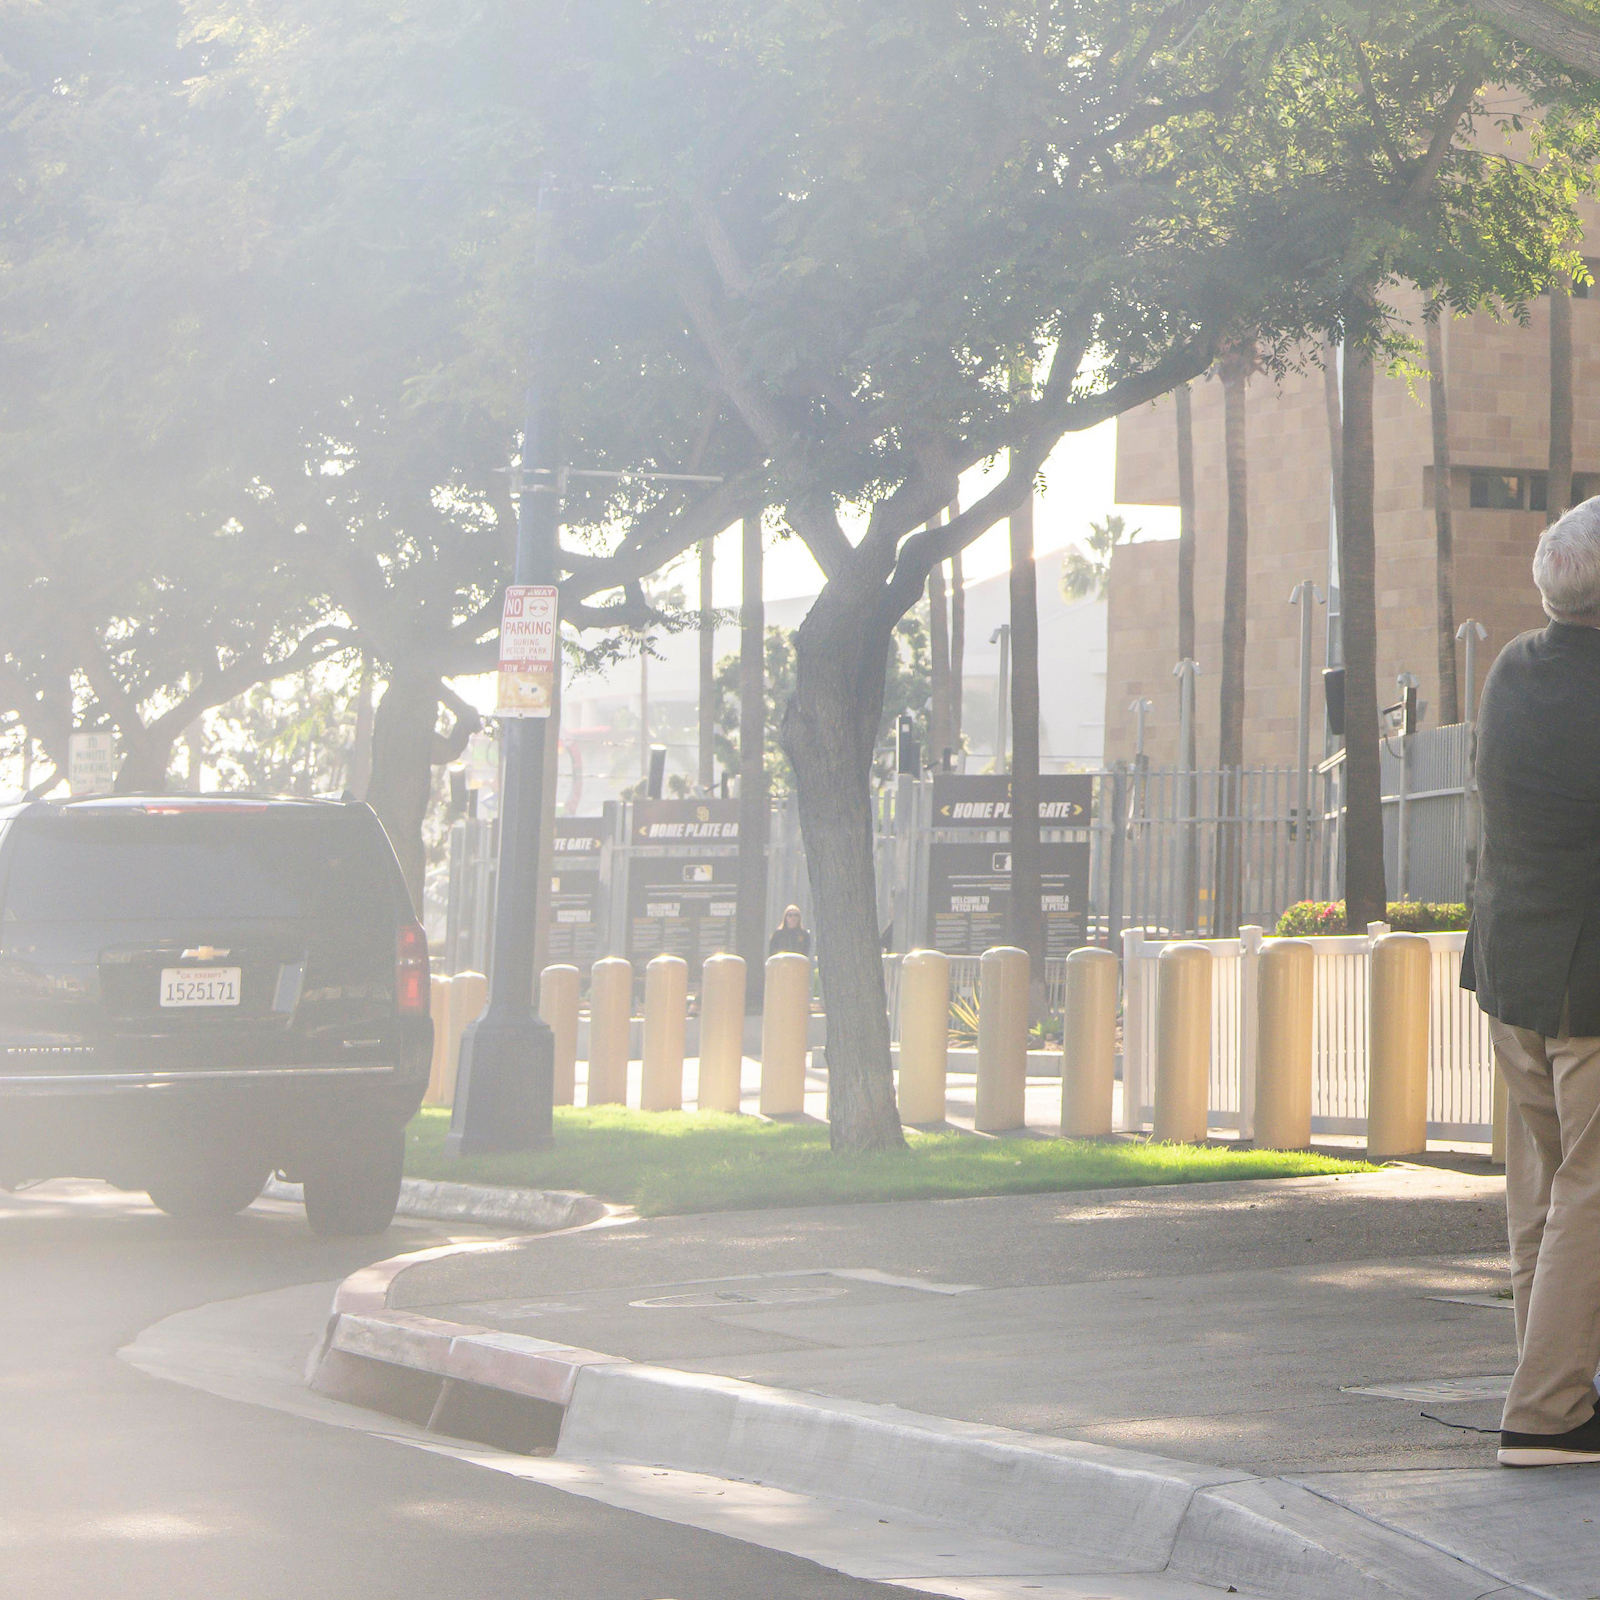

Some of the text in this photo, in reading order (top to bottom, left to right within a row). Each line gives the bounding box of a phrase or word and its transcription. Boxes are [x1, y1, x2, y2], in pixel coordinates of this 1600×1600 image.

[506, 598, 522, 616] NO
[505, 621, 552, 636] PARKING
[513, 638, 540, 647] DURING
[529, 646, 548, 655] PARK
[504, 664, 519, 673] TOW
[527, 664, 548, 673] AWAY
[952, 802, 994, 818] HOME
[1038, 802, 1071, 818] GATE
[649, 823, 685, 837] HOME
[684, 823, 722, 837] PLATE
[567, 837, 593, 850] GATE
[166, 981, 235, 1001] 1525171
